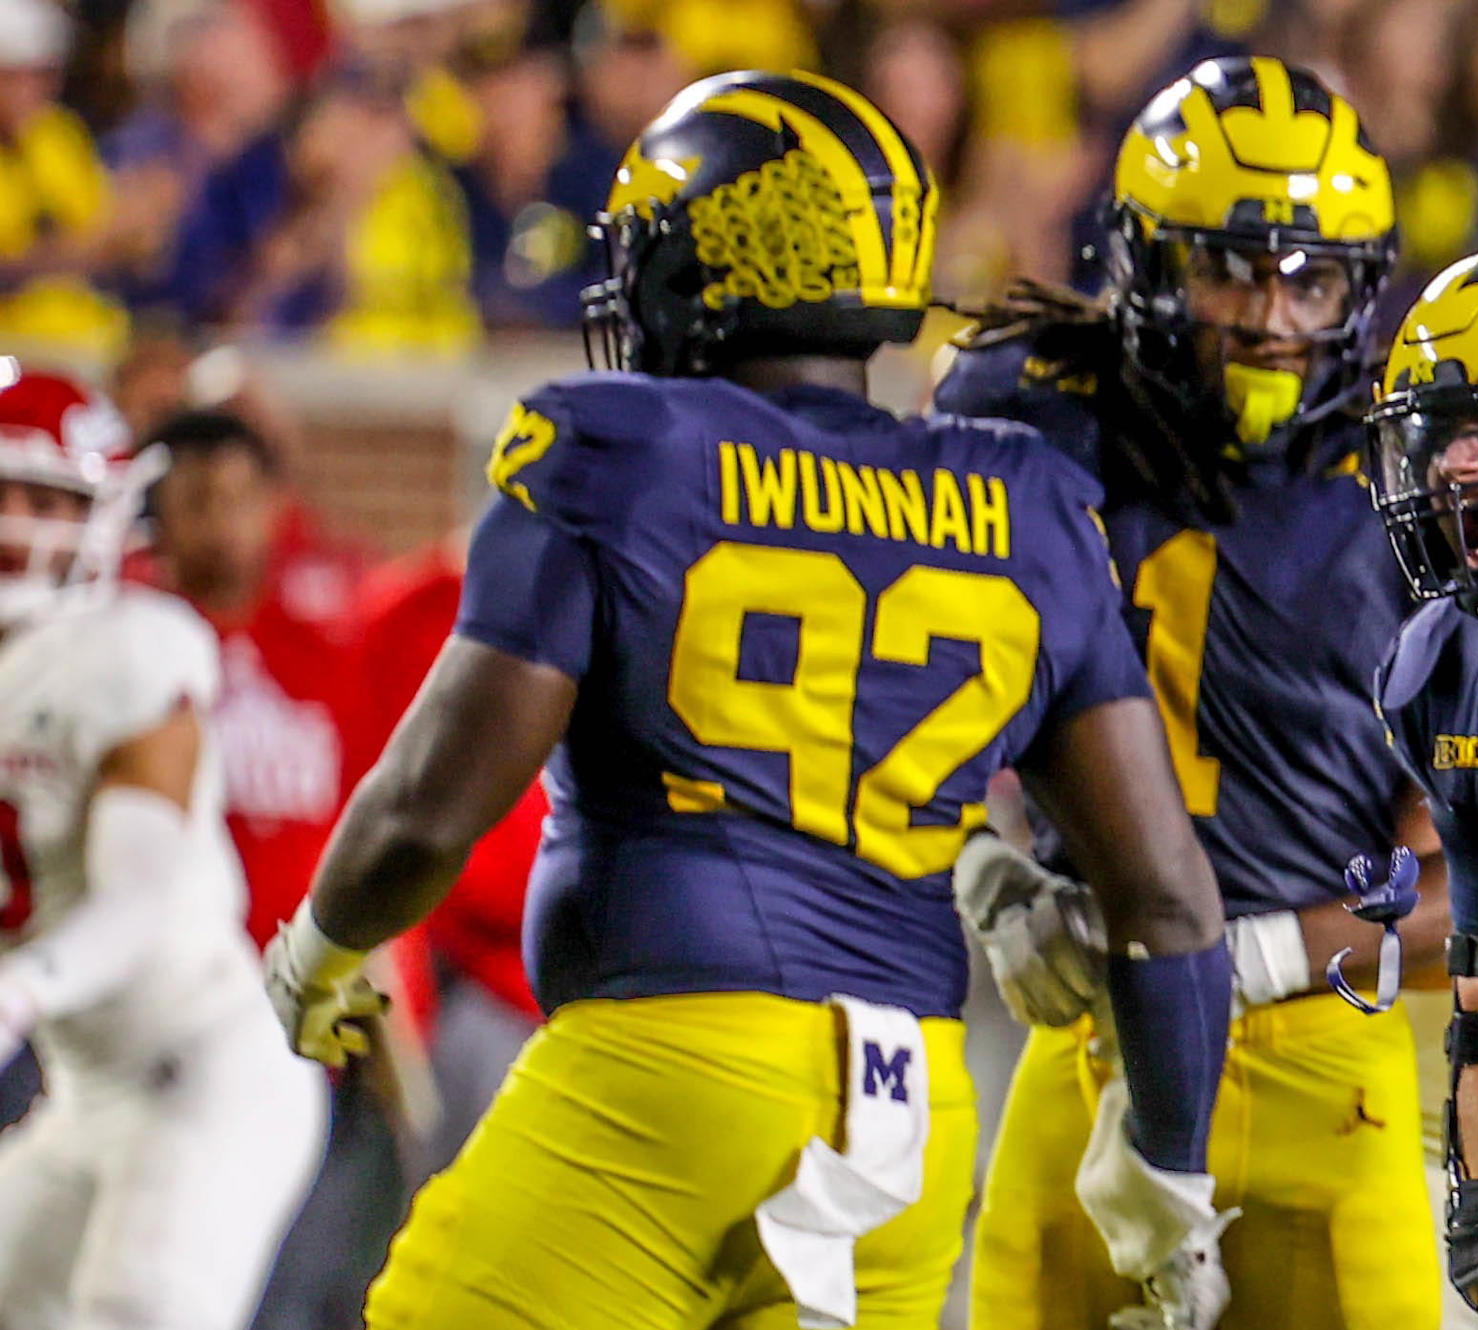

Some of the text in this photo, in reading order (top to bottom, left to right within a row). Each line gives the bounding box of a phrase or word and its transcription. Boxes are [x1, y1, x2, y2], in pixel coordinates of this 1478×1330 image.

[718, 440, 1012, 560] IWUNNAH
[662, 540, 1041, 880] 92
[1132, 528, 1221, 817] 1
[862, 1039, 913, 1105] M
